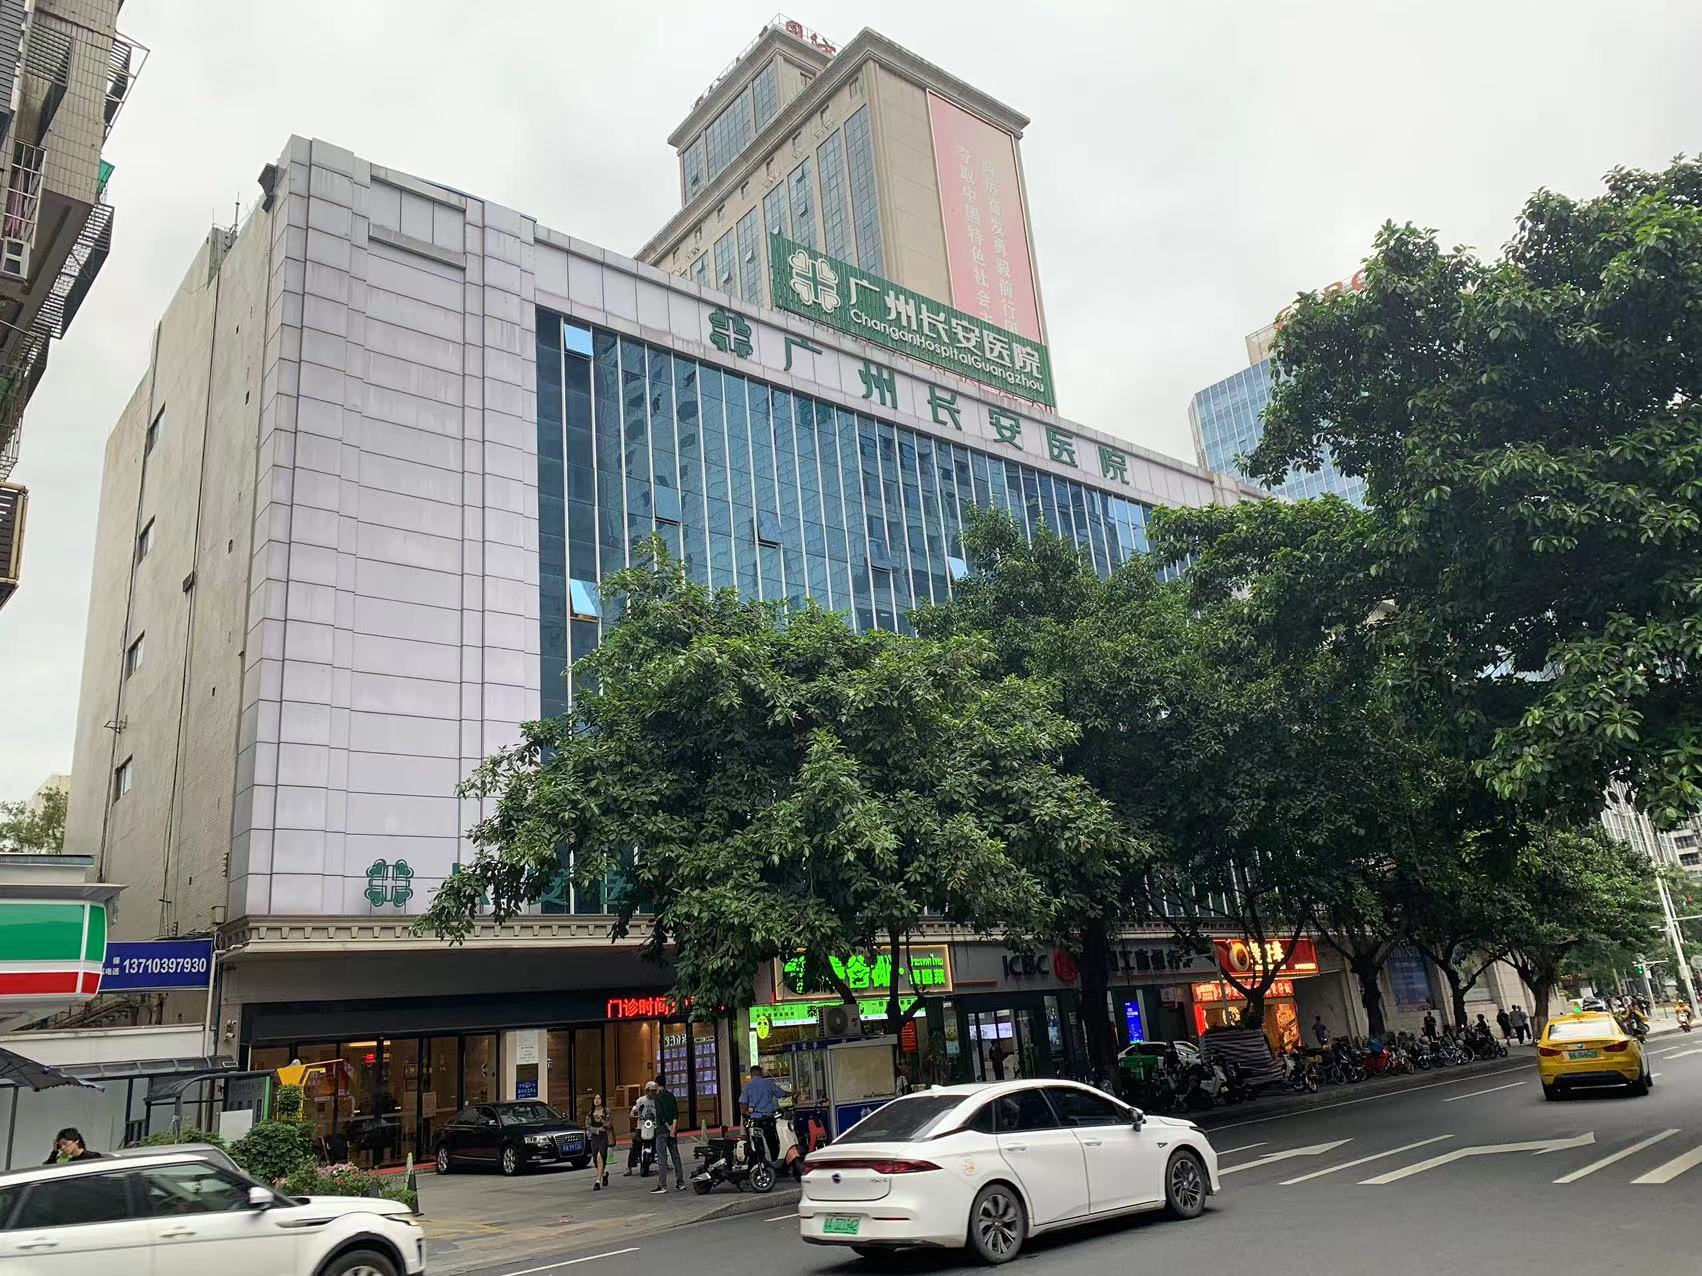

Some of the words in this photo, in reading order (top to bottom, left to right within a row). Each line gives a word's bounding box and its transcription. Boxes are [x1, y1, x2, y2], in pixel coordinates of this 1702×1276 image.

[849, 276, 1043, 379] 广州长安医院
[784, 336, 1131, 484] 广州长安医院
[123, 958, 207, 974] 13710397930
[1002, 954, 1051, 977] ICBC
